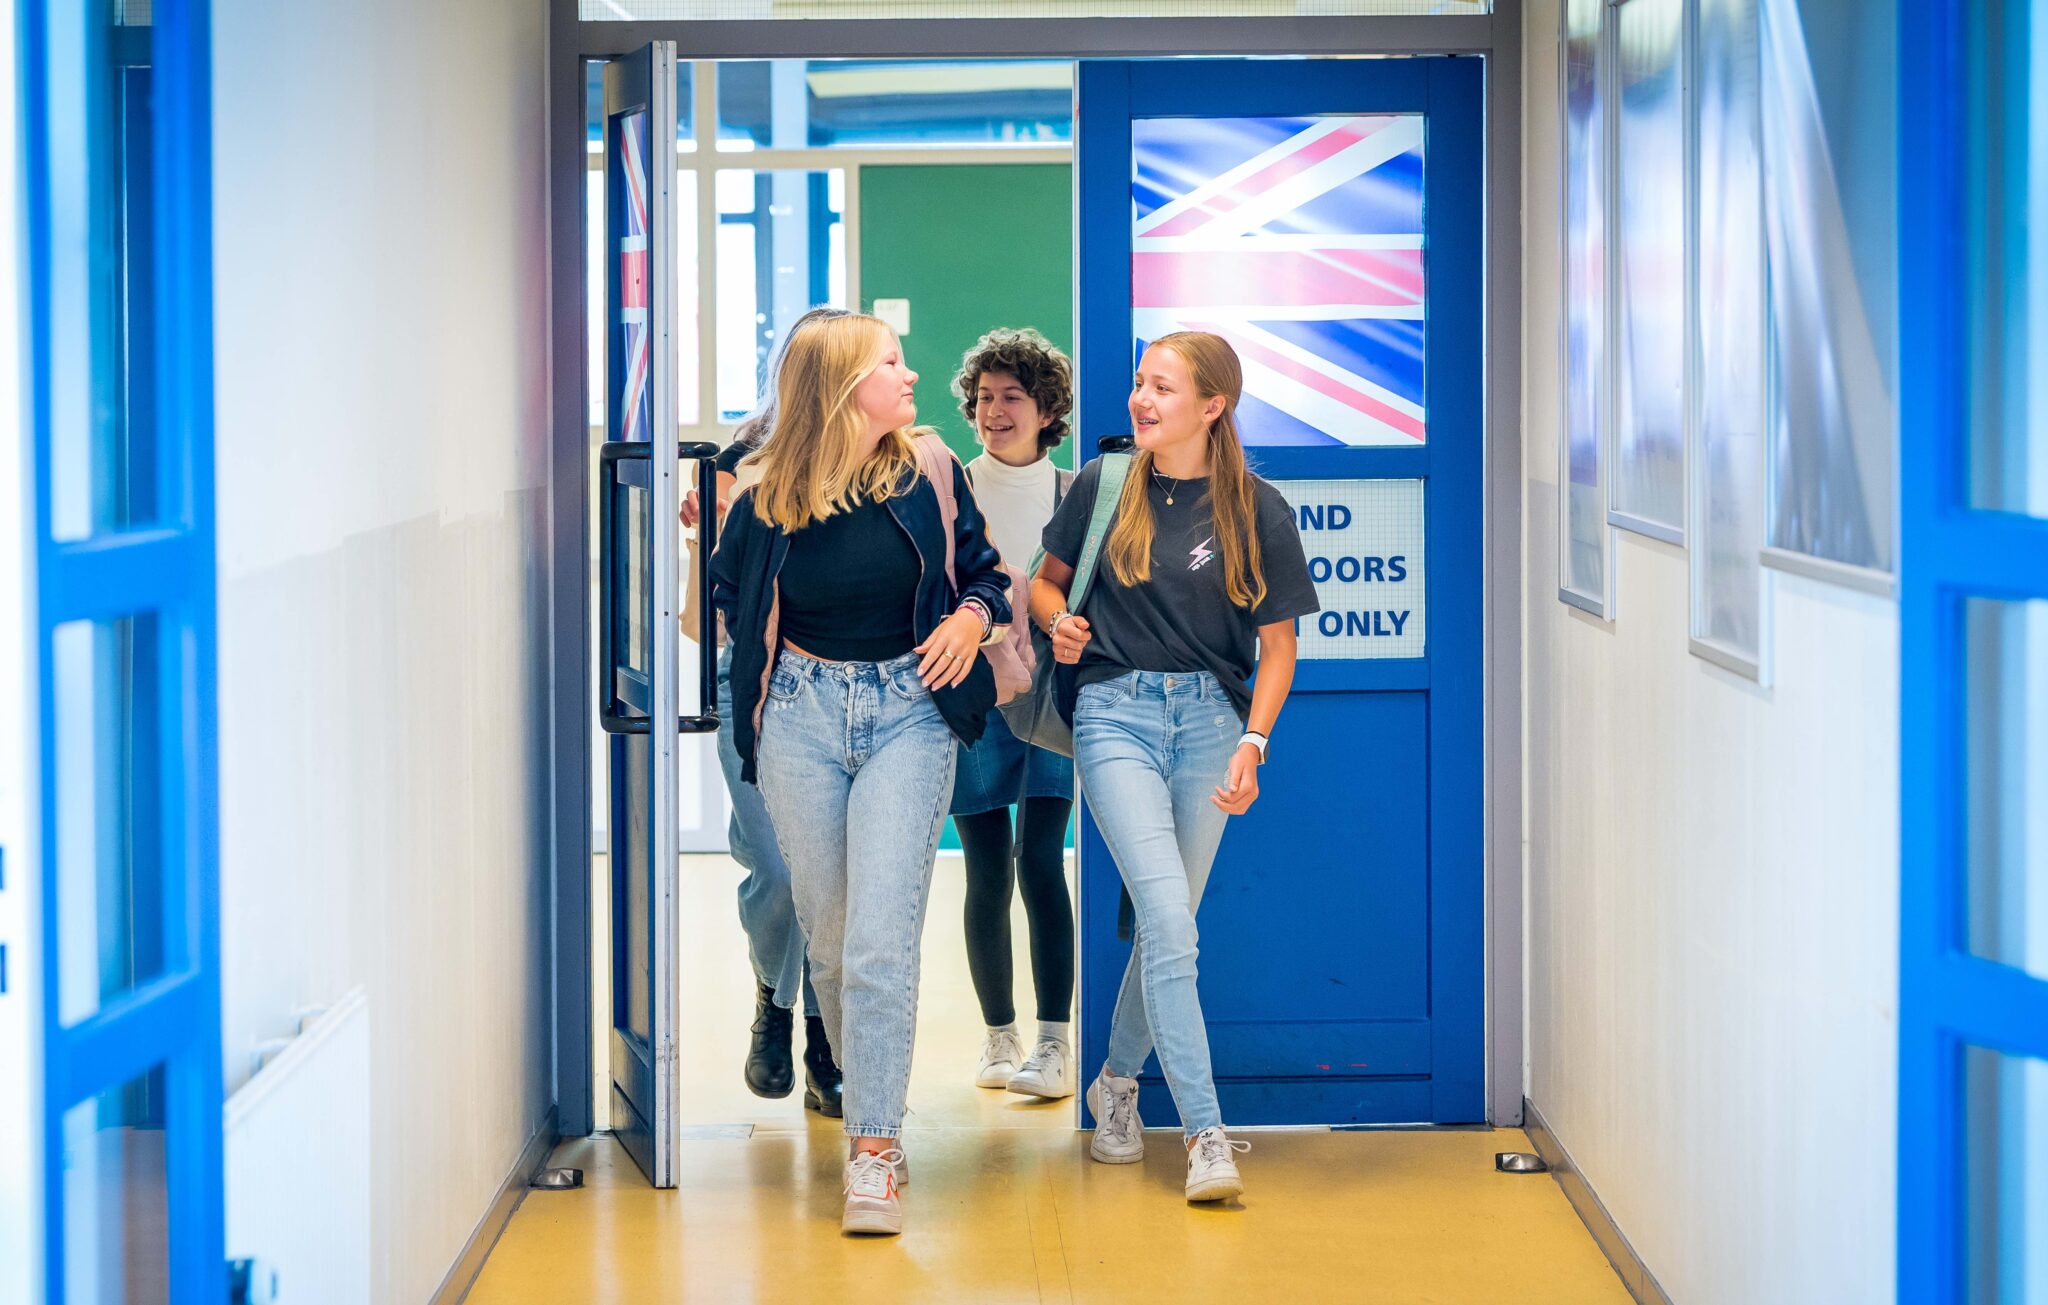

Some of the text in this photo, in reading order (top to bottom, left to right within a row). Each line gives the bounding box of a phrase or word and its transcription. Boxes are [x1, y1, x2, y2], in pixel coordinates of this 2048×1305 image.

[1291, 504, 1352, 531] ND
[1308, 556, 1407, 583] OORS
[1318, 610, 1411, 637] ONLY
